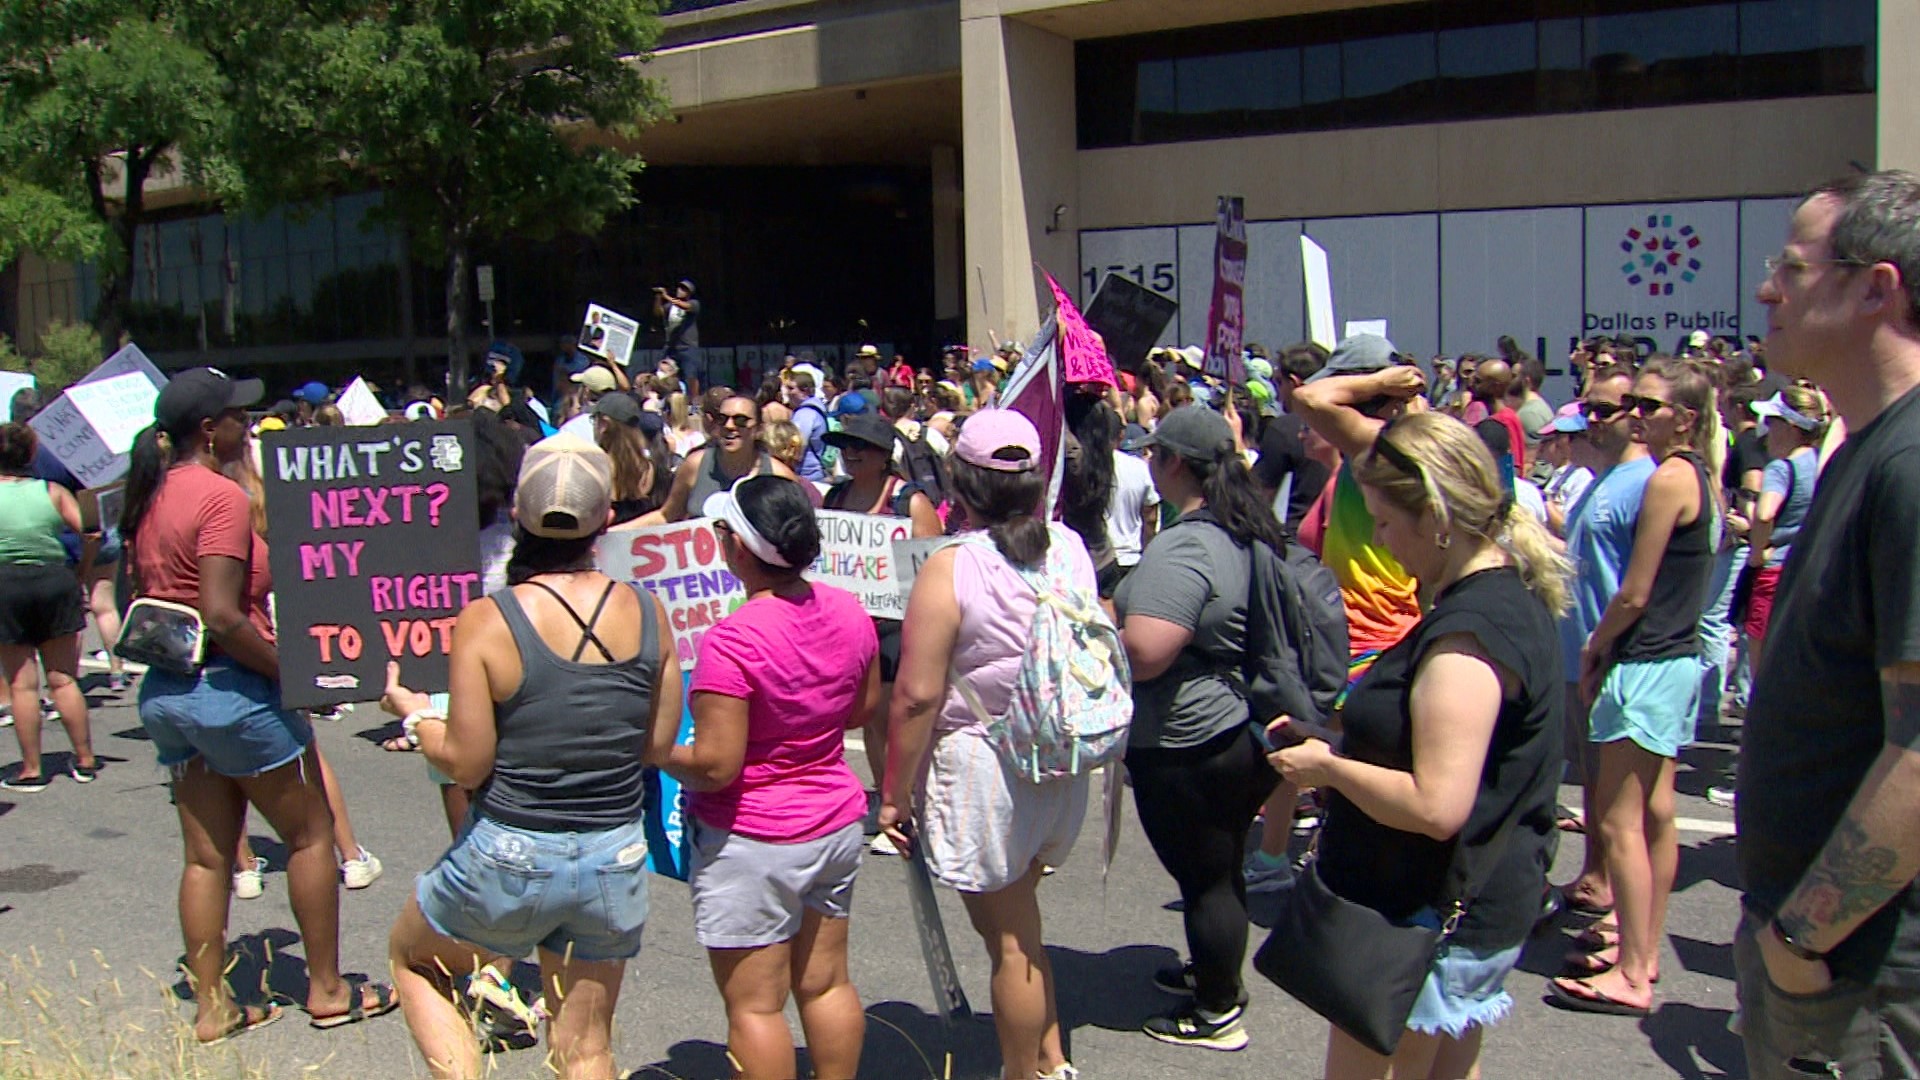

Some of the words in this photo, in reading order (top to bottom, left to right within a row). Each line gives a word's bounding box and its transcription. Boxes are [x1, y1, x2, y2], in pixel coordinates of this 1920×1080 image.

[1084, 264, 1174, 292] 115
[1585, 312, 1656, 330] Dallas
[1665, 311, 1740, 330] Public
[276, 435, 425, 482] WHAT'S
[311, 482, 450, 530] NEXT?
[816, 517, 864, 546] TION
[869, 520, 886, 549] IS
[300, 540, 365, 581] MY
[370, 572, 479, 613] RIGHT
[672, 599, 722, 632] CARE
[308, 623, 363, 663] TO
[380, 616, 458, 658] VOT
[664, 782, 684, 848] ABO
